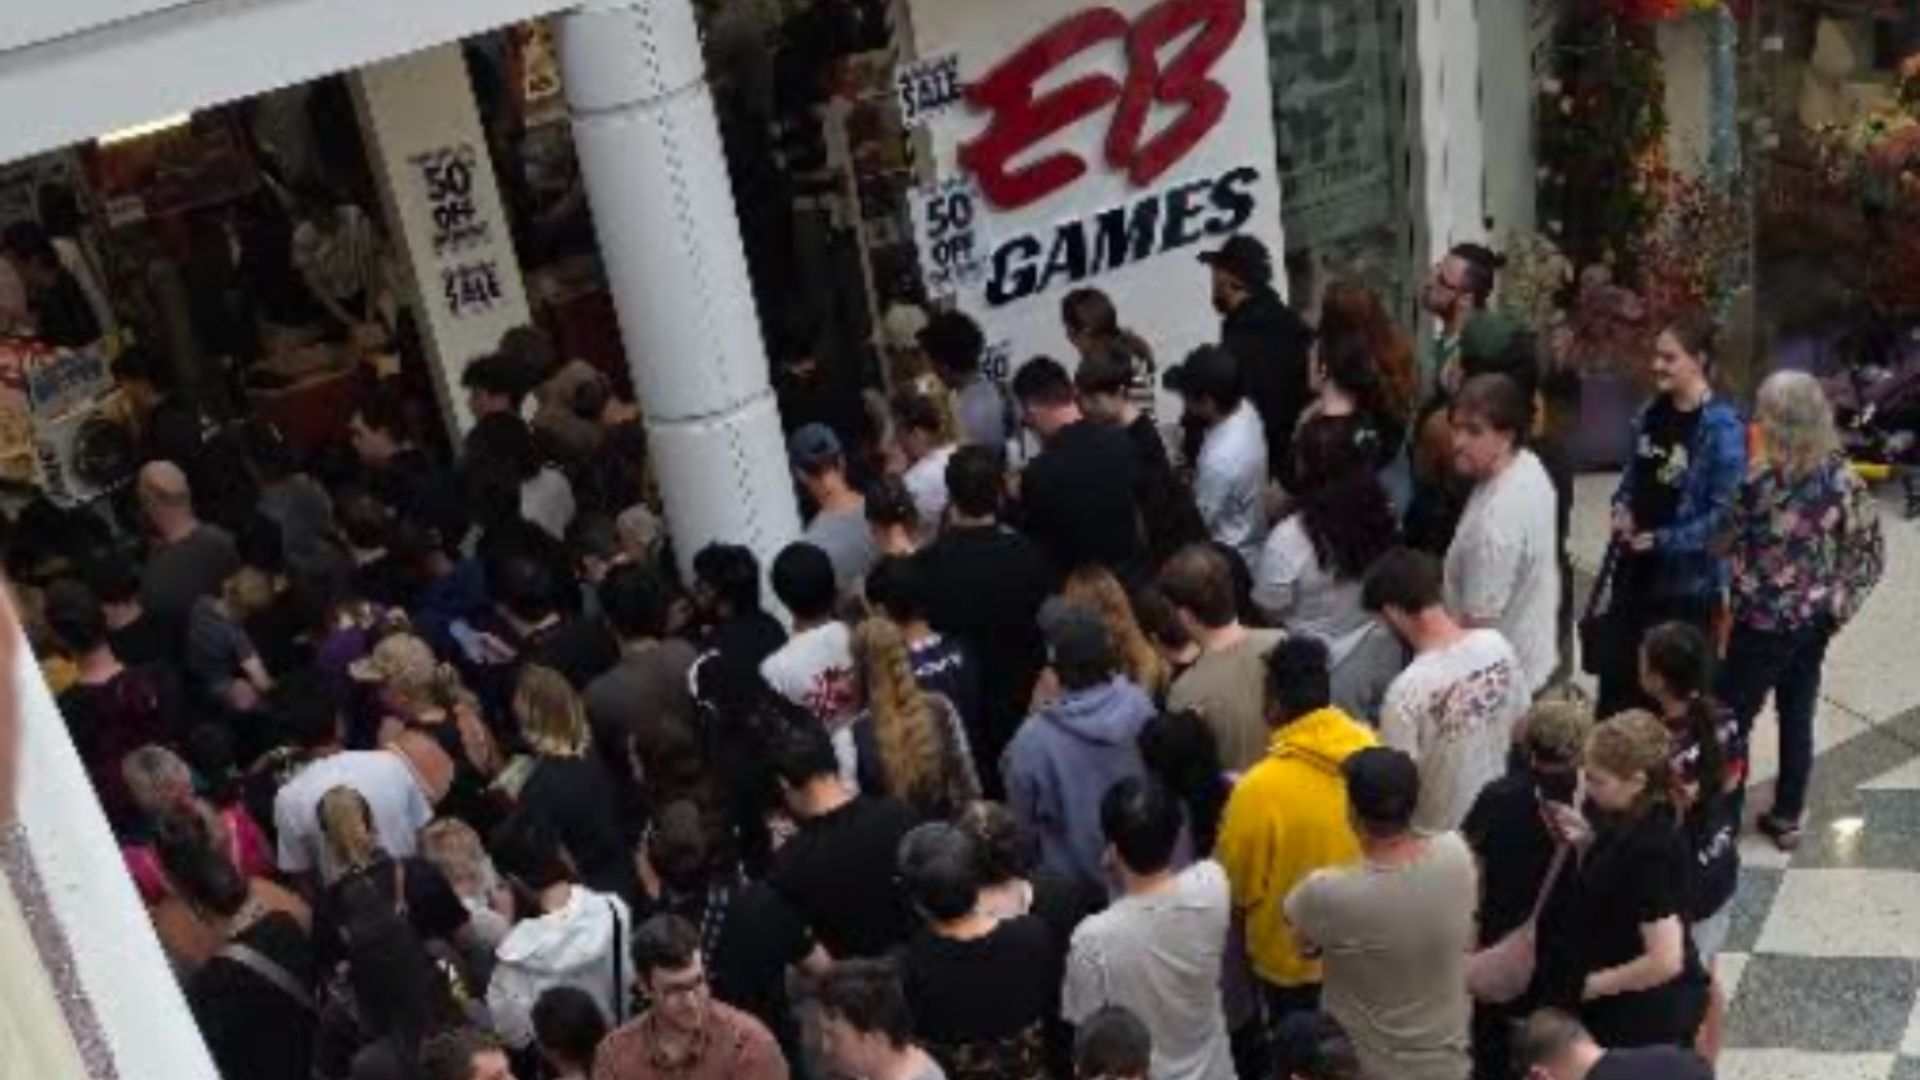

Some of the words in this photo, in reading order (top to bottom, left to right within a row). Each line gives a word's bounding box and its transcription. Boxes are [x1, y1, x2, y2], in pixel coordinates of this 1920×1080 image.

[959, 0, 1247, 211] EB
[424, 161, 472, 200] 50
[927, 193, 973, 239] 50
[985, 166, 1261, 306] GAMES
